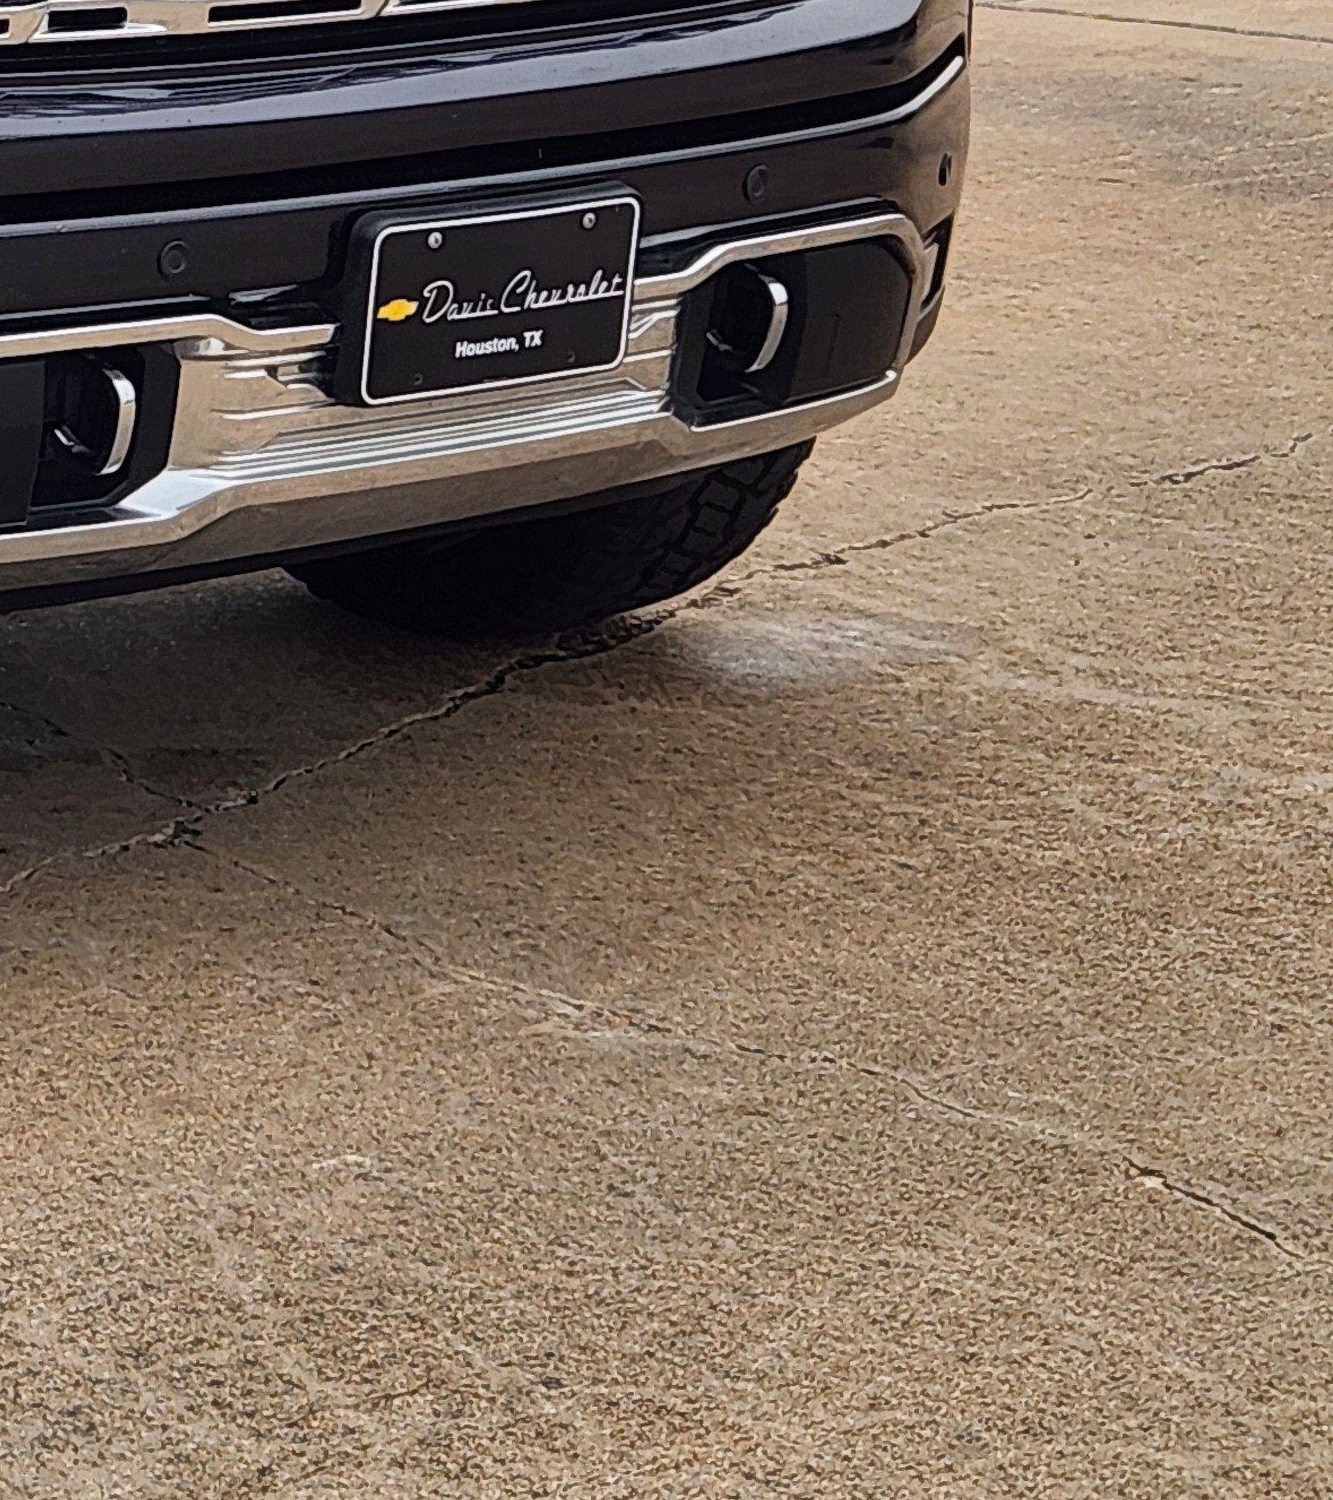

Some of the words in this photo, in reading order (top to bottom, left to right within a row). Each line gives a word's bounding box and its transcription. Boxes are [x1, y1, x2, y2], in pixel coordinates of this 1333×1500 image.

[421, 280, 499, 324] Davis
[499, 269, 625, 314] Chevrolet
[454, 337, 520, 359] Houston,
[522, 329, 544, 347] TX
